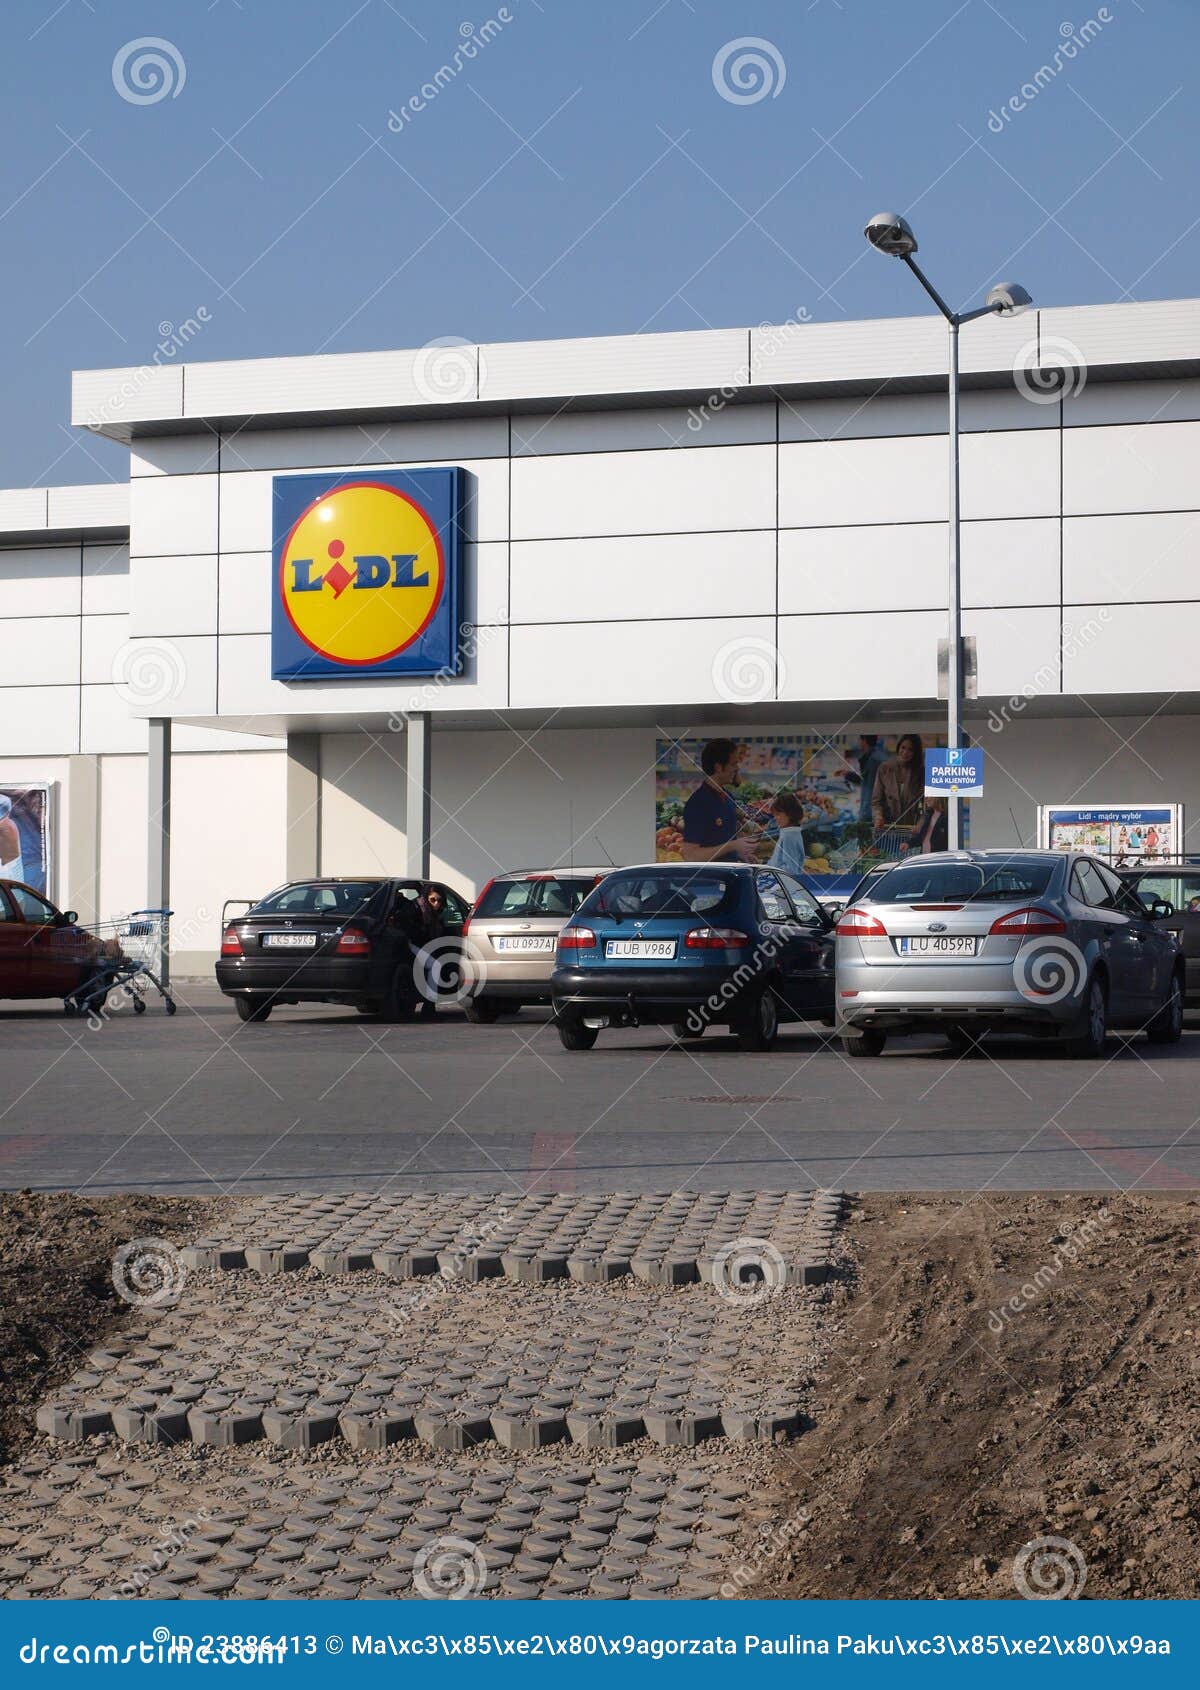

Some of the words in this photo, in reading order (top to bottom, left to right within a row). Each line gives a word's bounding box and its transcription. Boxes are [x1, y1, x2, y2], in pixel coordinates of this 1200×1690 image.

[949, 751, 959, 764] P
[932, 767, 976, 776] PARKING
[944, 776, 976, 784] KLIENTÓW
[1098, 812, 1119, 821] mądry
[1121, 812, 1142, 821] wybór
[506, 938, 519, 949] LU
[522, 938, 551, 949] 0937A
[911, 937, 928, 950] LU
[933, 937, 973, 951] 4059R
[616, 944, 640, 955] LUB
[645, 944, 672, 955] V986
